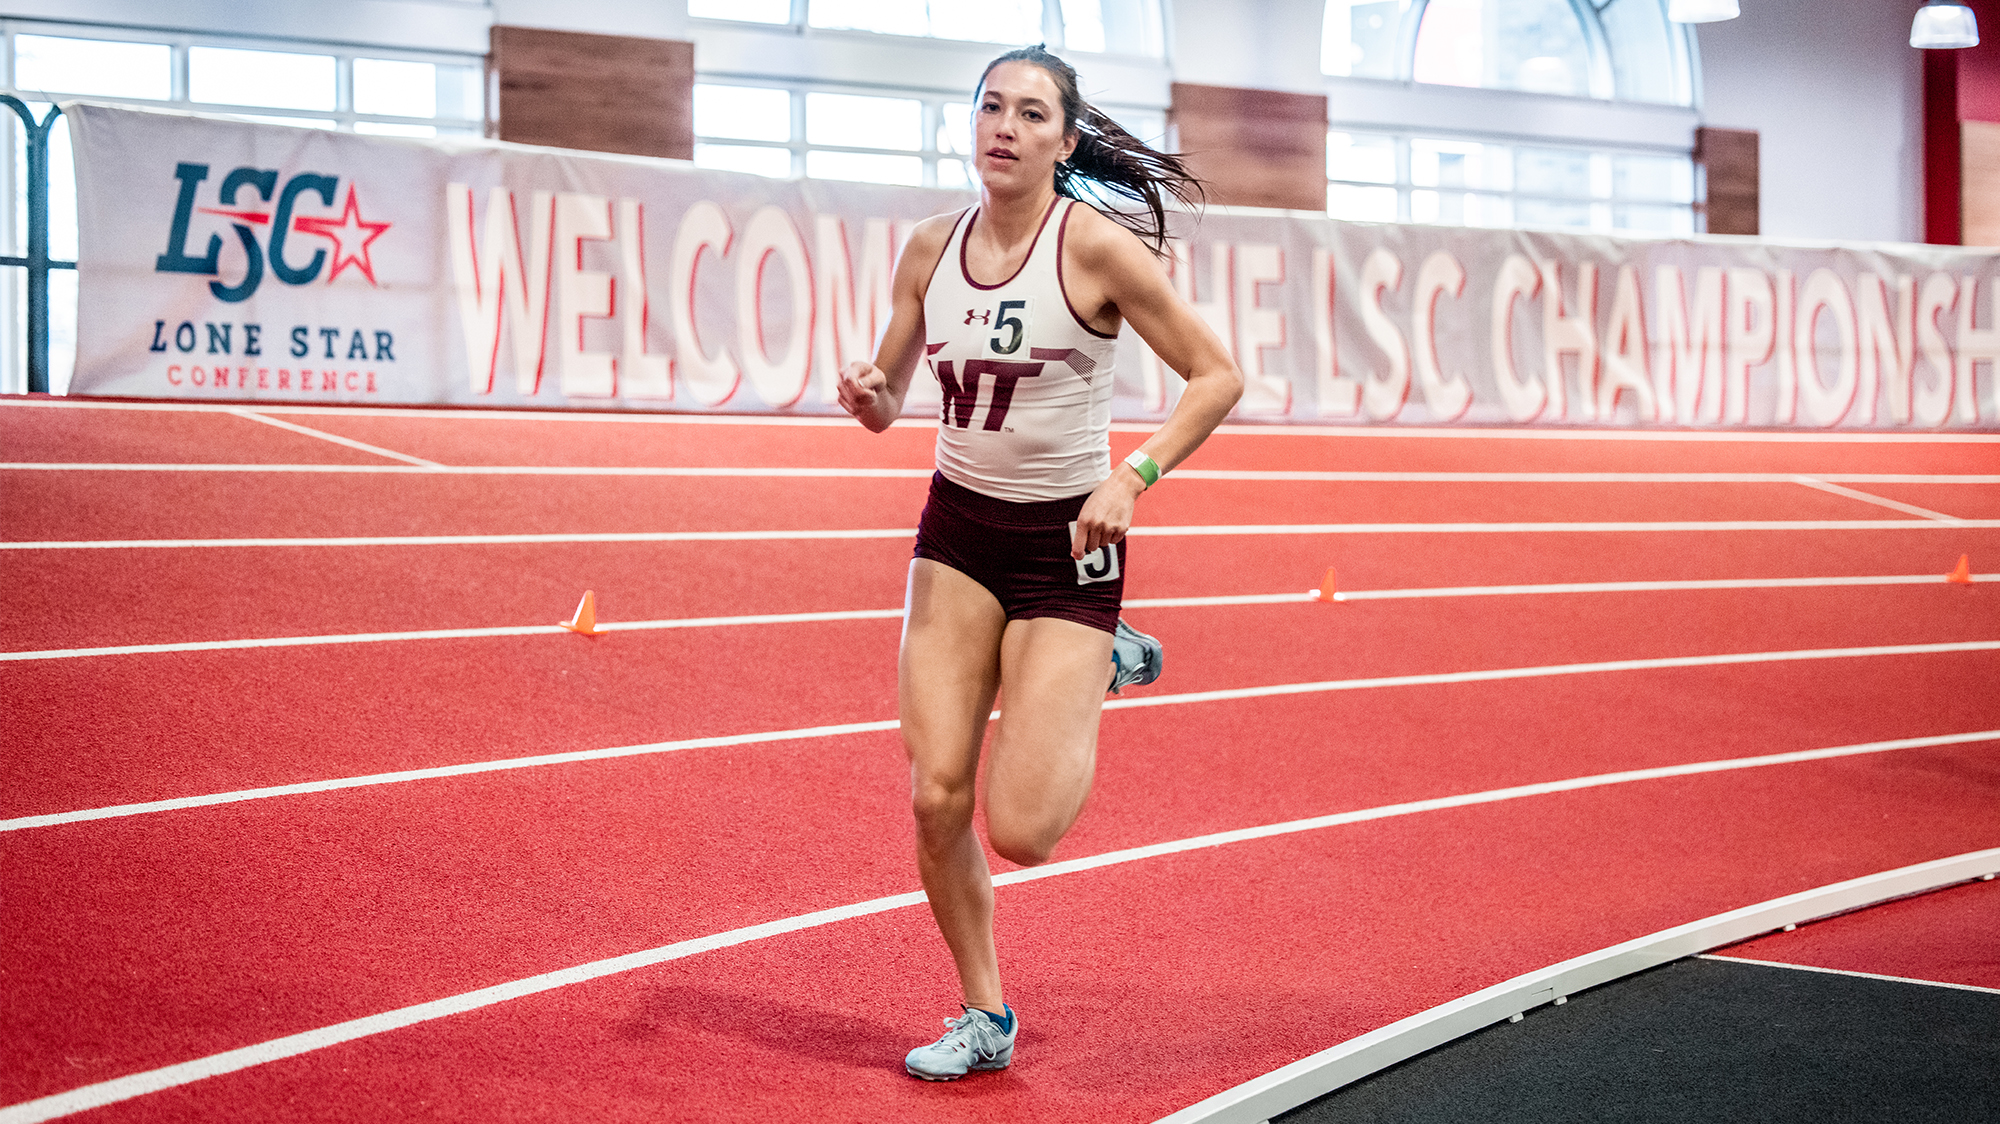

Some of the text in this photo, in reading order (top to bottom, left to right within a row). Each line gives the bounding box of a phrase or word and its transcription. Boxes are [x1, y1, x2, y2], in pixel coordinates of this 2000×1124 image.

[155, 162, 339, 303] LSC
[447, 183, 936, 408] WELCOM
[1311, 246, 1474, 422] LSC
[990, 300, 1026, 355] 5
[150, 320, 395, 361] LONE STAR
[167, 365, 378, 393] CONFERENCE
